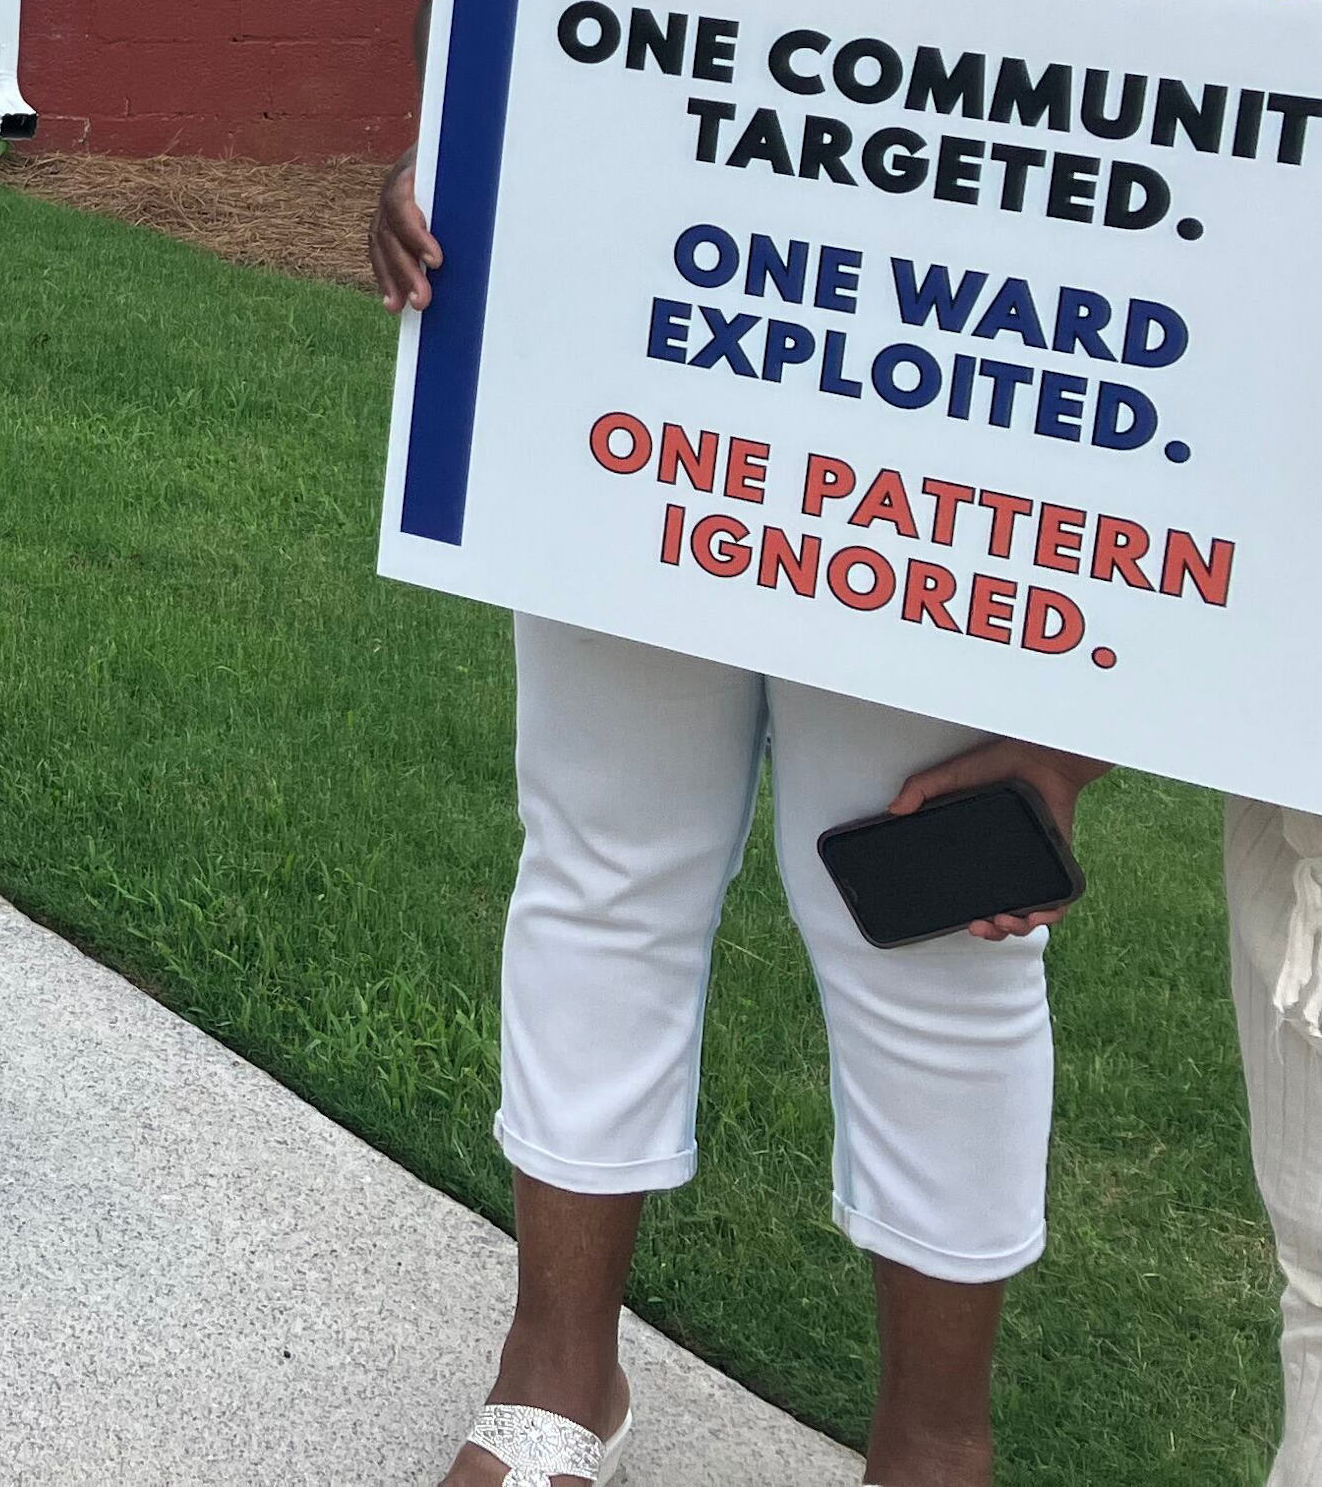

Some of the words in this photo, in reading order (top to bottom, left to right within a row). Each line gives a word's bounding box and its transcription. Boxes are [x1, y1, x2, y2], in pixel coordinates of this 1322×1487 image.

[557, 0, 741, 83] ONE
[686, 98, 1206, 242] TARGETED.
[674, 222, 863, 314] ONE
[890, 255, 1190, 371] WARD
[647, 296, 1193, 463] EXPLOITED.
[588, 411, 770, 506] ONE
[801, 451, 1238, 608] PATTERN
[659, 504, 1118, 670] IGNORED.
